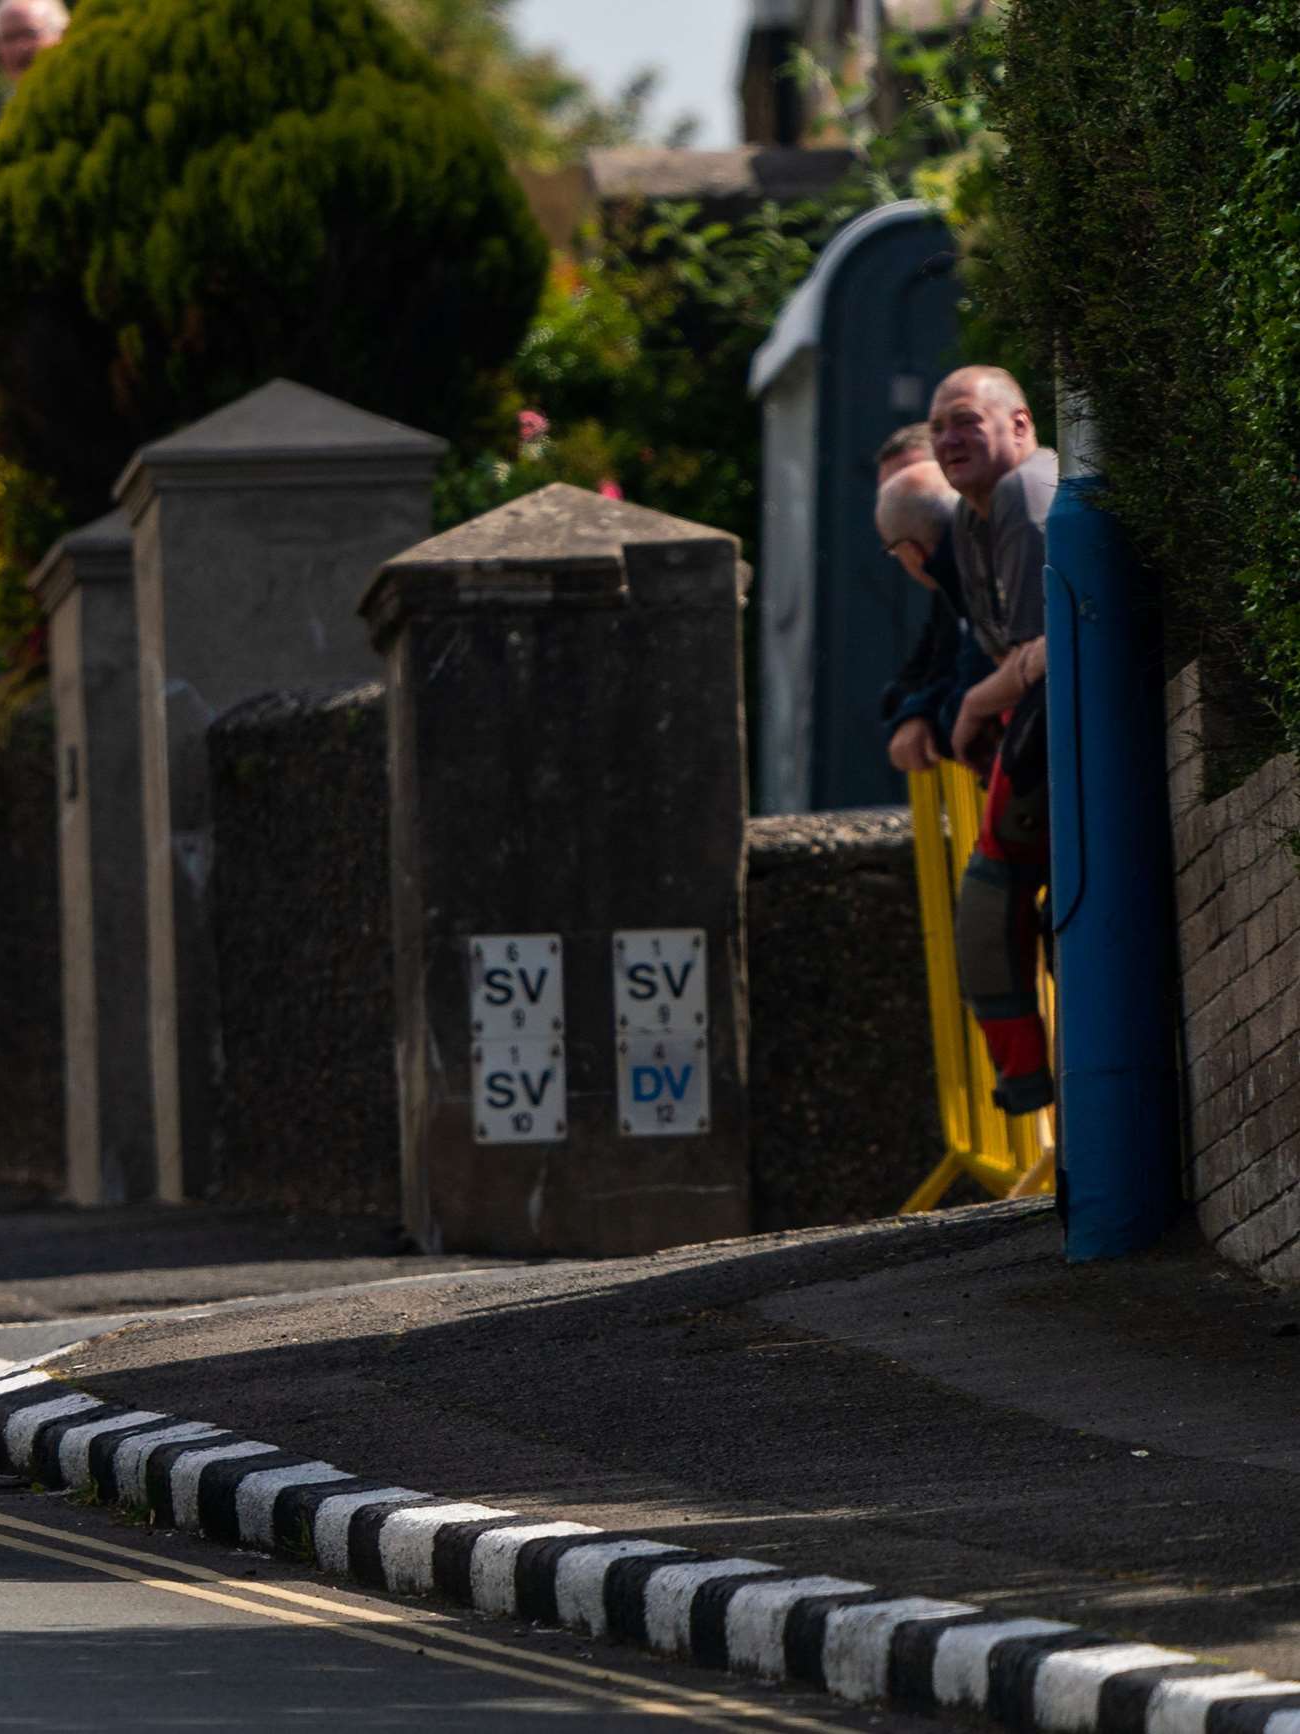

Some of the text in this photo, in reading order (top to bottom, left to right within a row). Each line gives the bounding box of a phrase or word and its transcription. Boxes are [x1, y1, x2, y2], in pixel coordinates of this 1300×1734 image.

[484, 967, 549, 1006] SV
[627, 961, 695, 1001] SV
[485, 1069, 554, 1109] SV
[631, 1064, 694, 1102] DV
[510, 1111, 534, 1134] 10
